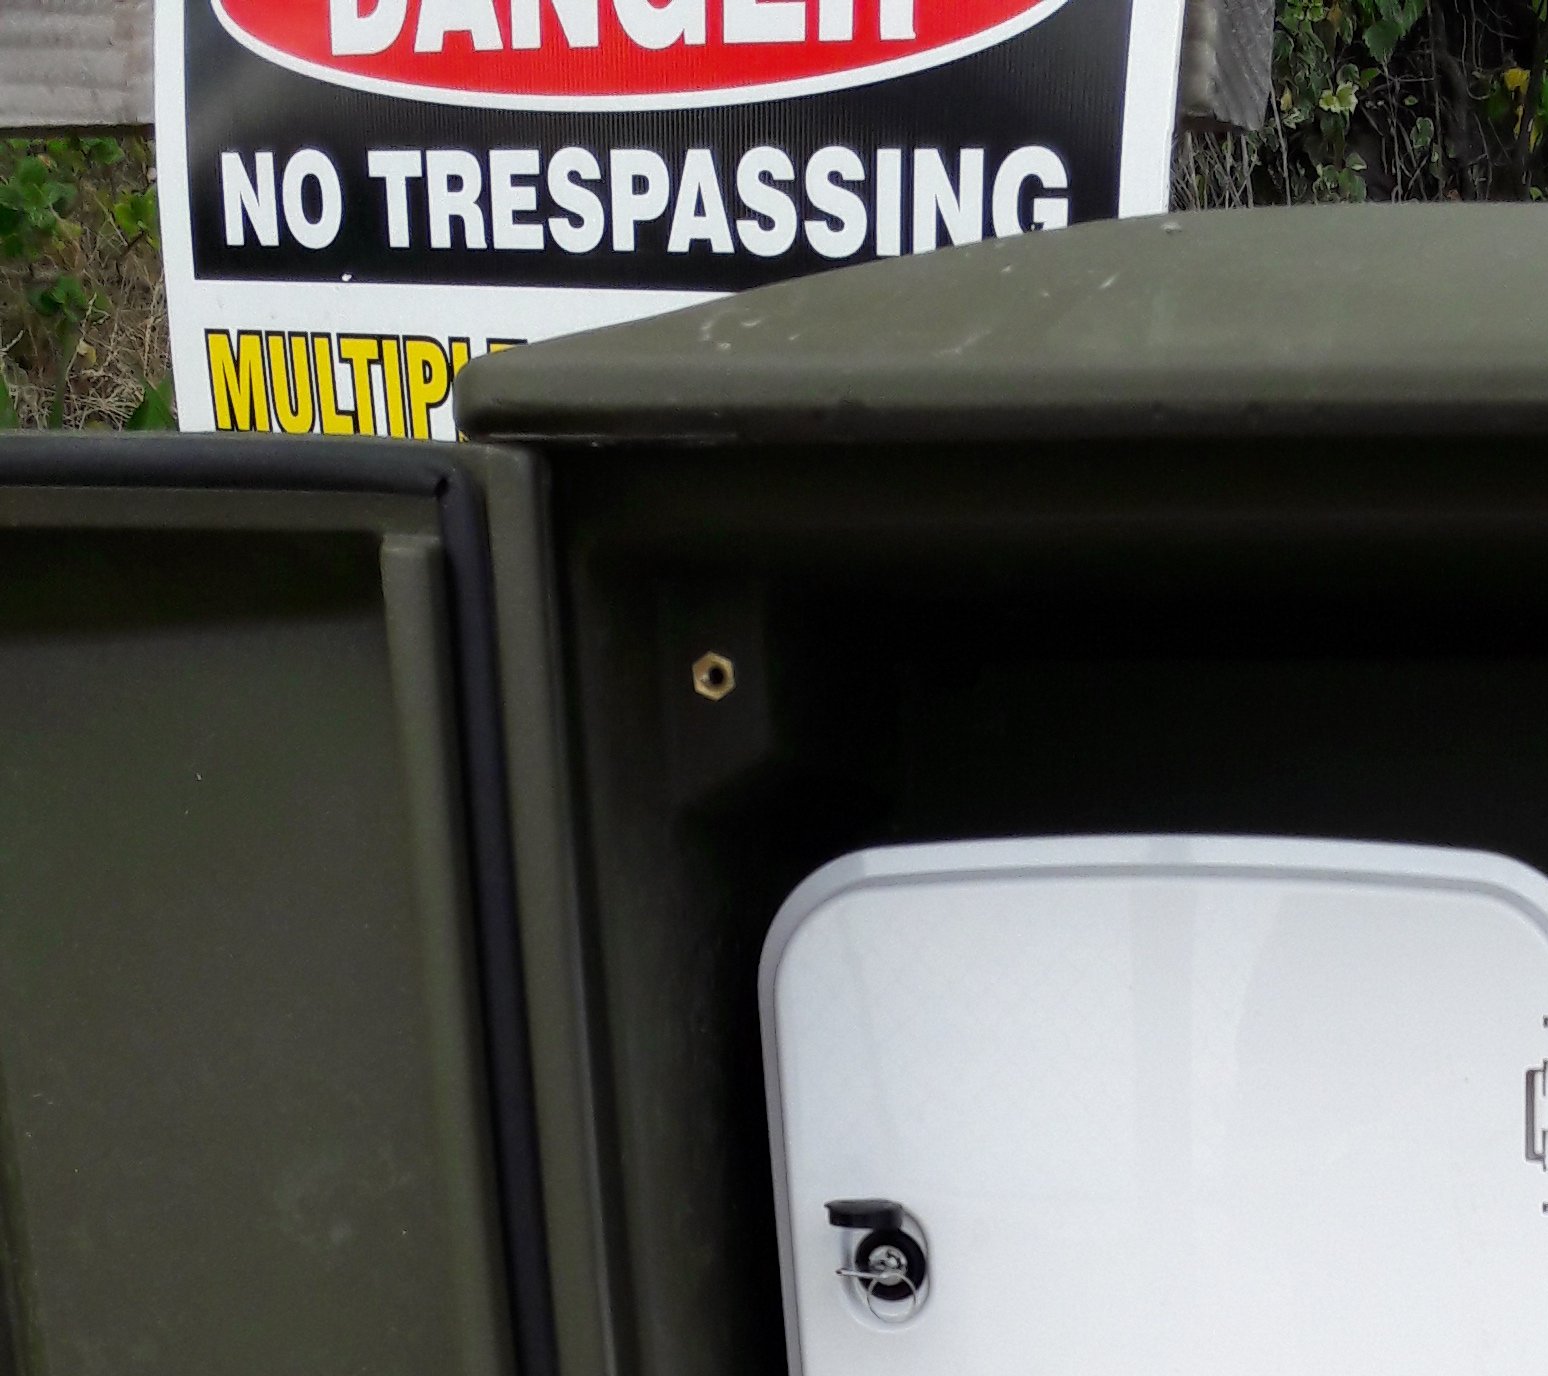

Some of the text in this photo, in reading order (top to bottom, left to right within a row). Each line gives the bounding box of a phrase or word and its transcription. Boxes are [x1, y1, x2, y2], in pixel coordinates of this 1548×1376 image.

[221, 145, 1069, 258] NO TRESPASSING
[204, 328, 528, 442] MULTIP
